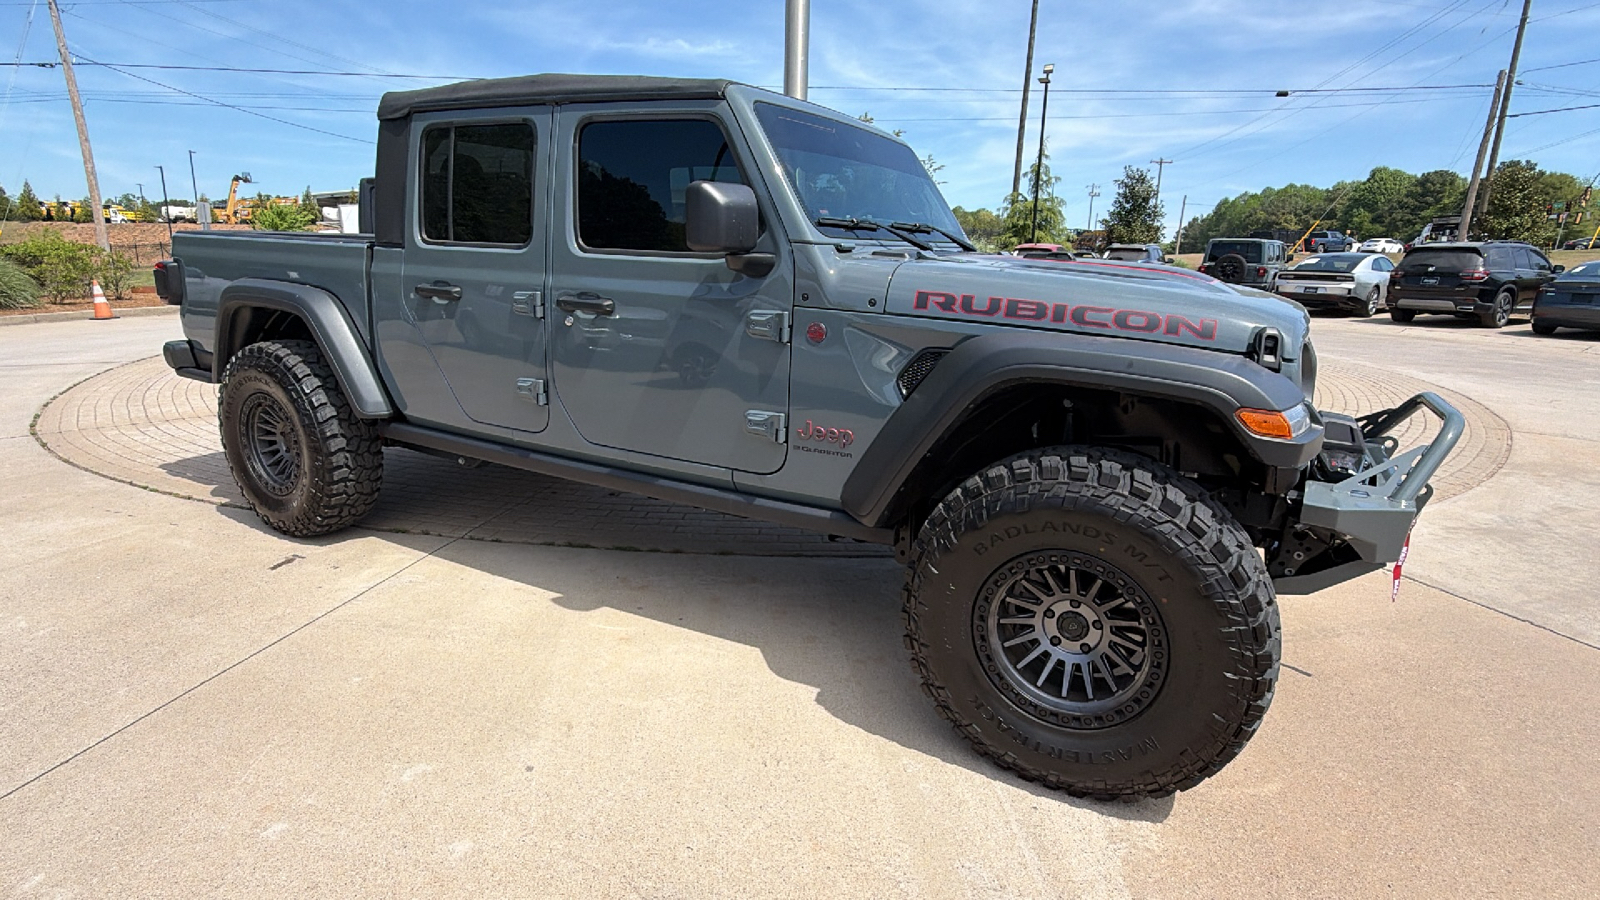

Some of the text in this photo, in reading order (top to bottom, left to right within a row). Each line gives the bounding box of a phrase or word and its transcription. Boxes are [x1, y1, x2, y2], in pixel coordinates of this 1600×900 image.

[913, 290, 1219, 341] RUBICON
[797, 419, 854, 449] Jeep
[801, 446, 853, 458] GLADIATOR
[973, 521, 1174, 583] BADLANDS M/T
[971, 693, 1161, 765] MASTERTRACK
